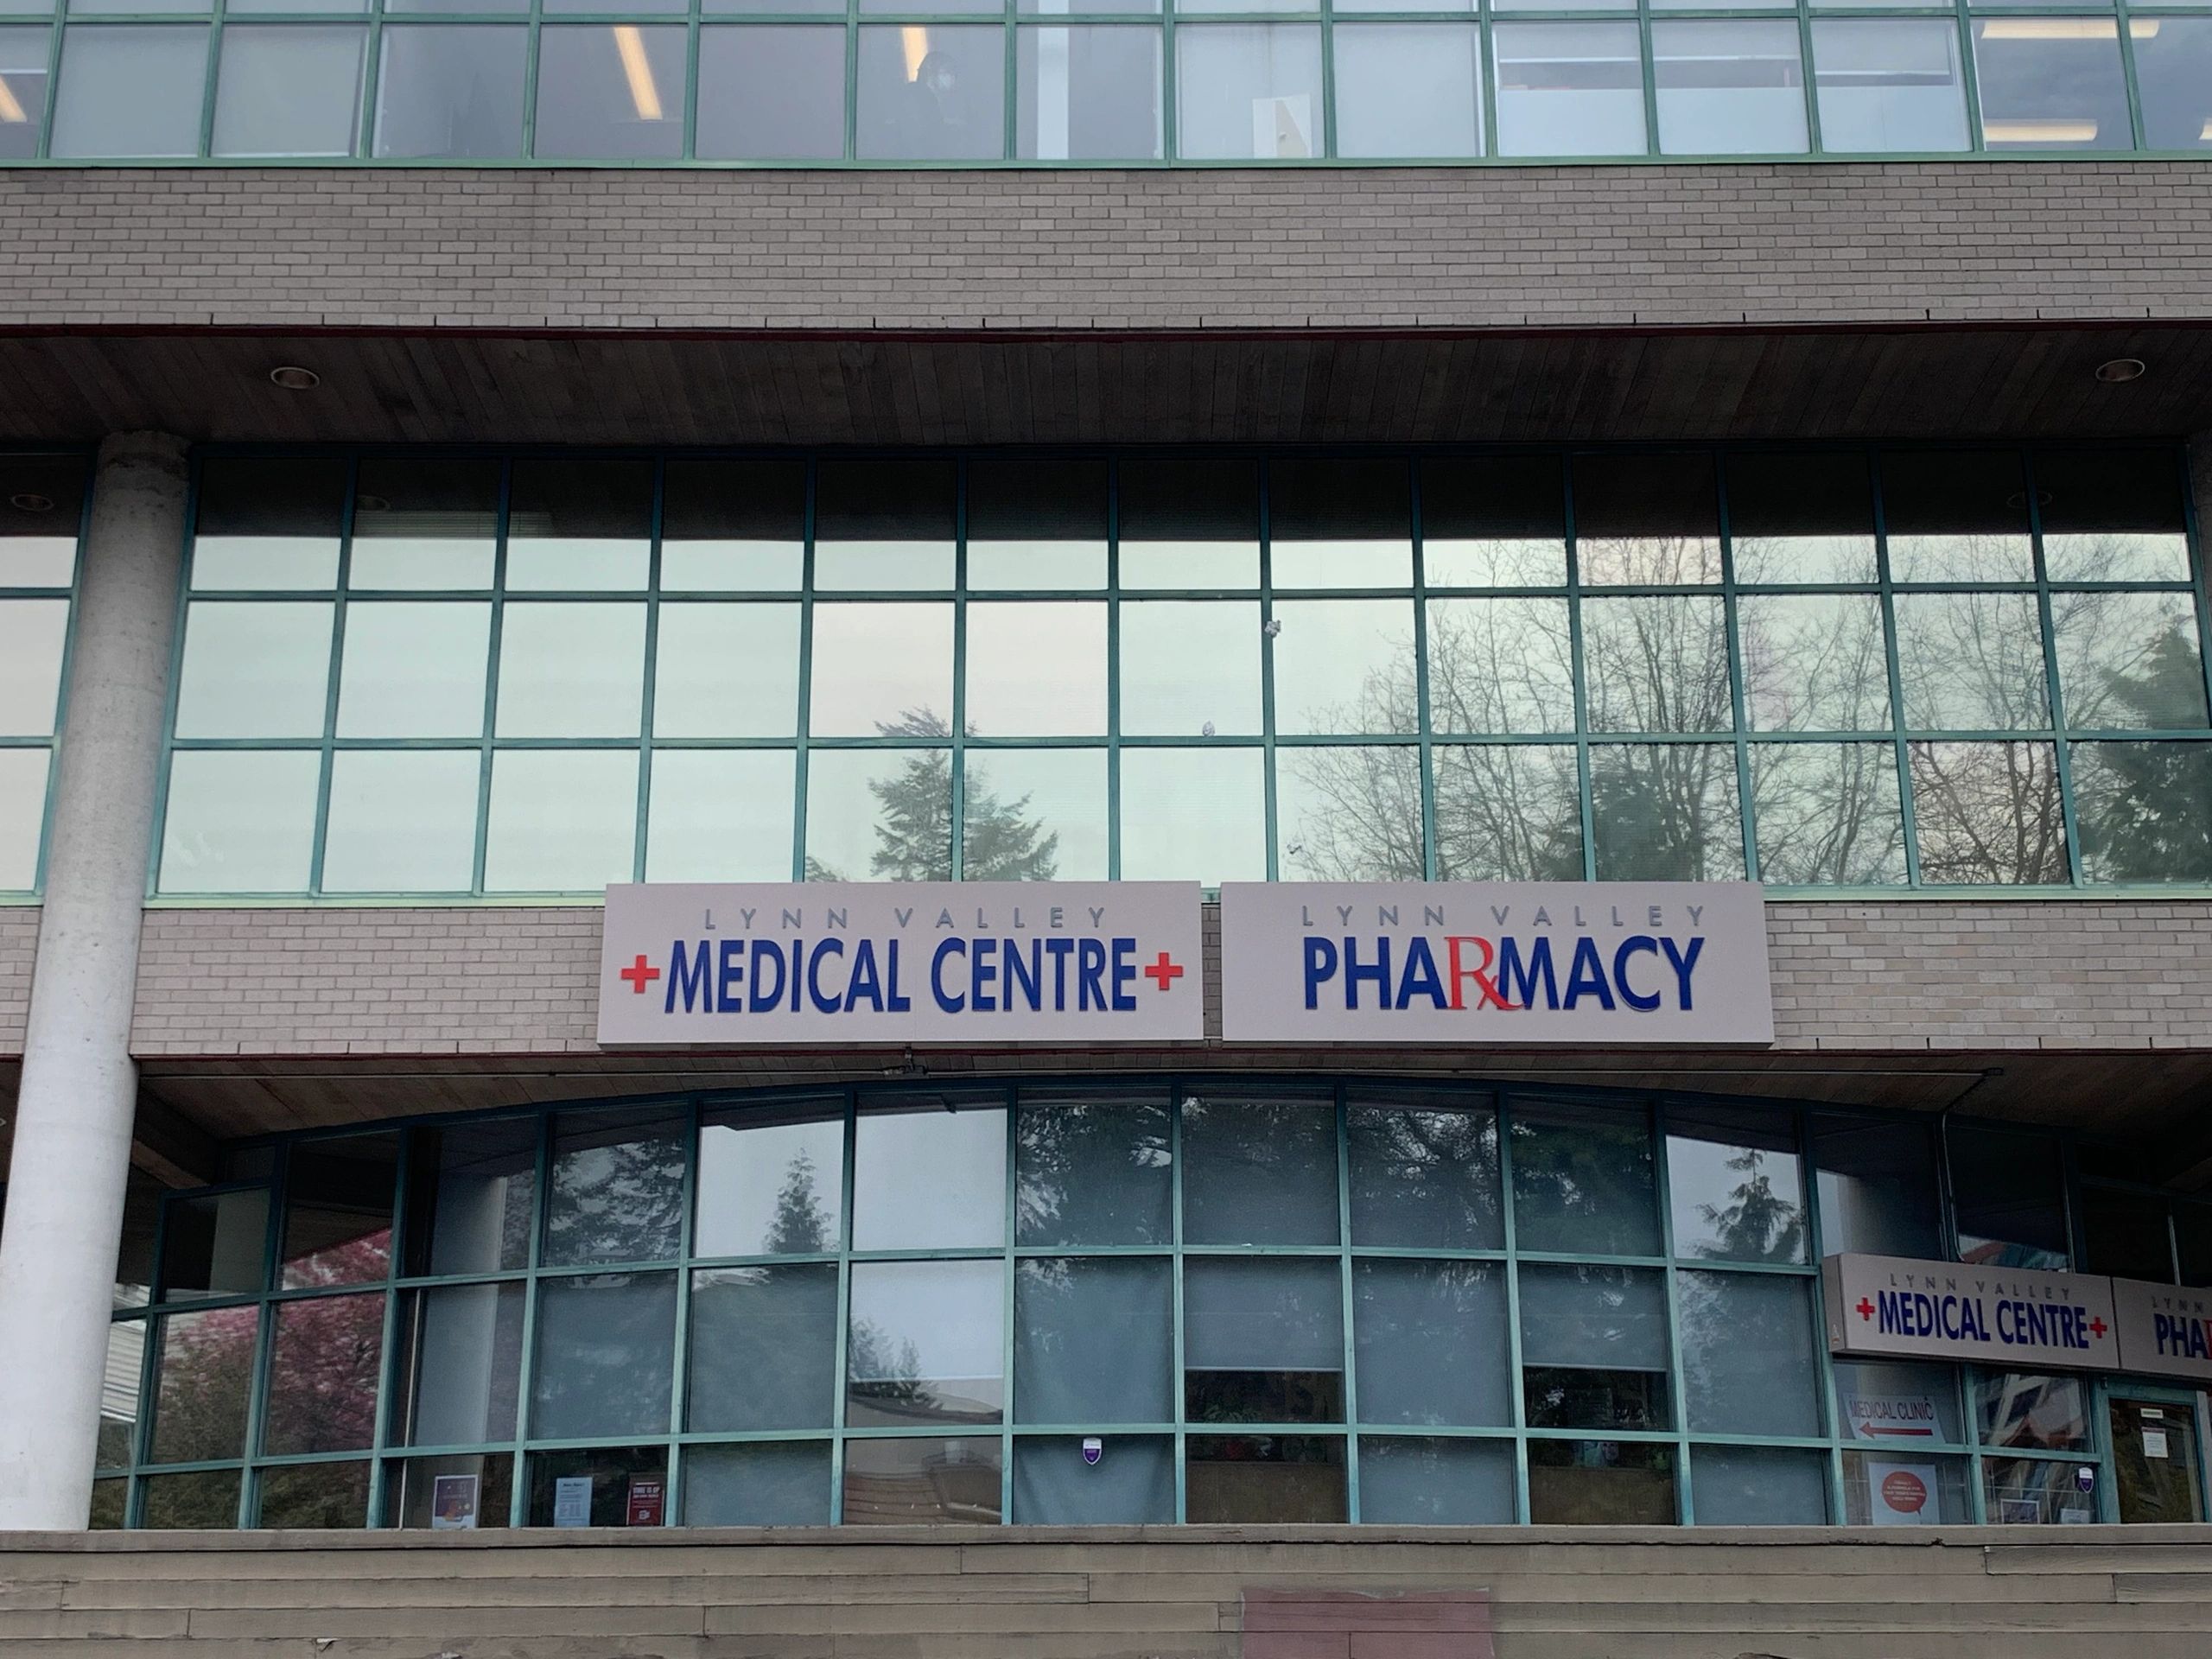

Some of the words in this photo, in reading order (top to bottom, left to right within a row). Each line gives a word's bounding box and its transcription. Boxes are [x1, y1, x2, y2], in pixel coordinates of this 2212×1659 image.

[704, 906, 849, 931] LYNN
[894, 906, 1106, 930] VALLEY
[1301, 905, 1446, 927] LYNN
[1491, 905, 1706, 927] VALLEY
[664, 937, 912, 1014] MEDICAL
[930, 936, 1137, 1013] CENTRE
[1303, 934, 1707, 1013] PHARMACY
[1890, 1272, 1957, 1291] LYNN
[1975, 1280, 2070, 1300] VALLEY
[1878, 1289, 1991, 1342] MEDICAL
[1996, 1299, 2090, 1350] CENTRE
[1849, 1399, 1897, 1420] MEDICAL
[1897, 1401, 1935, 1421] CLINIC
